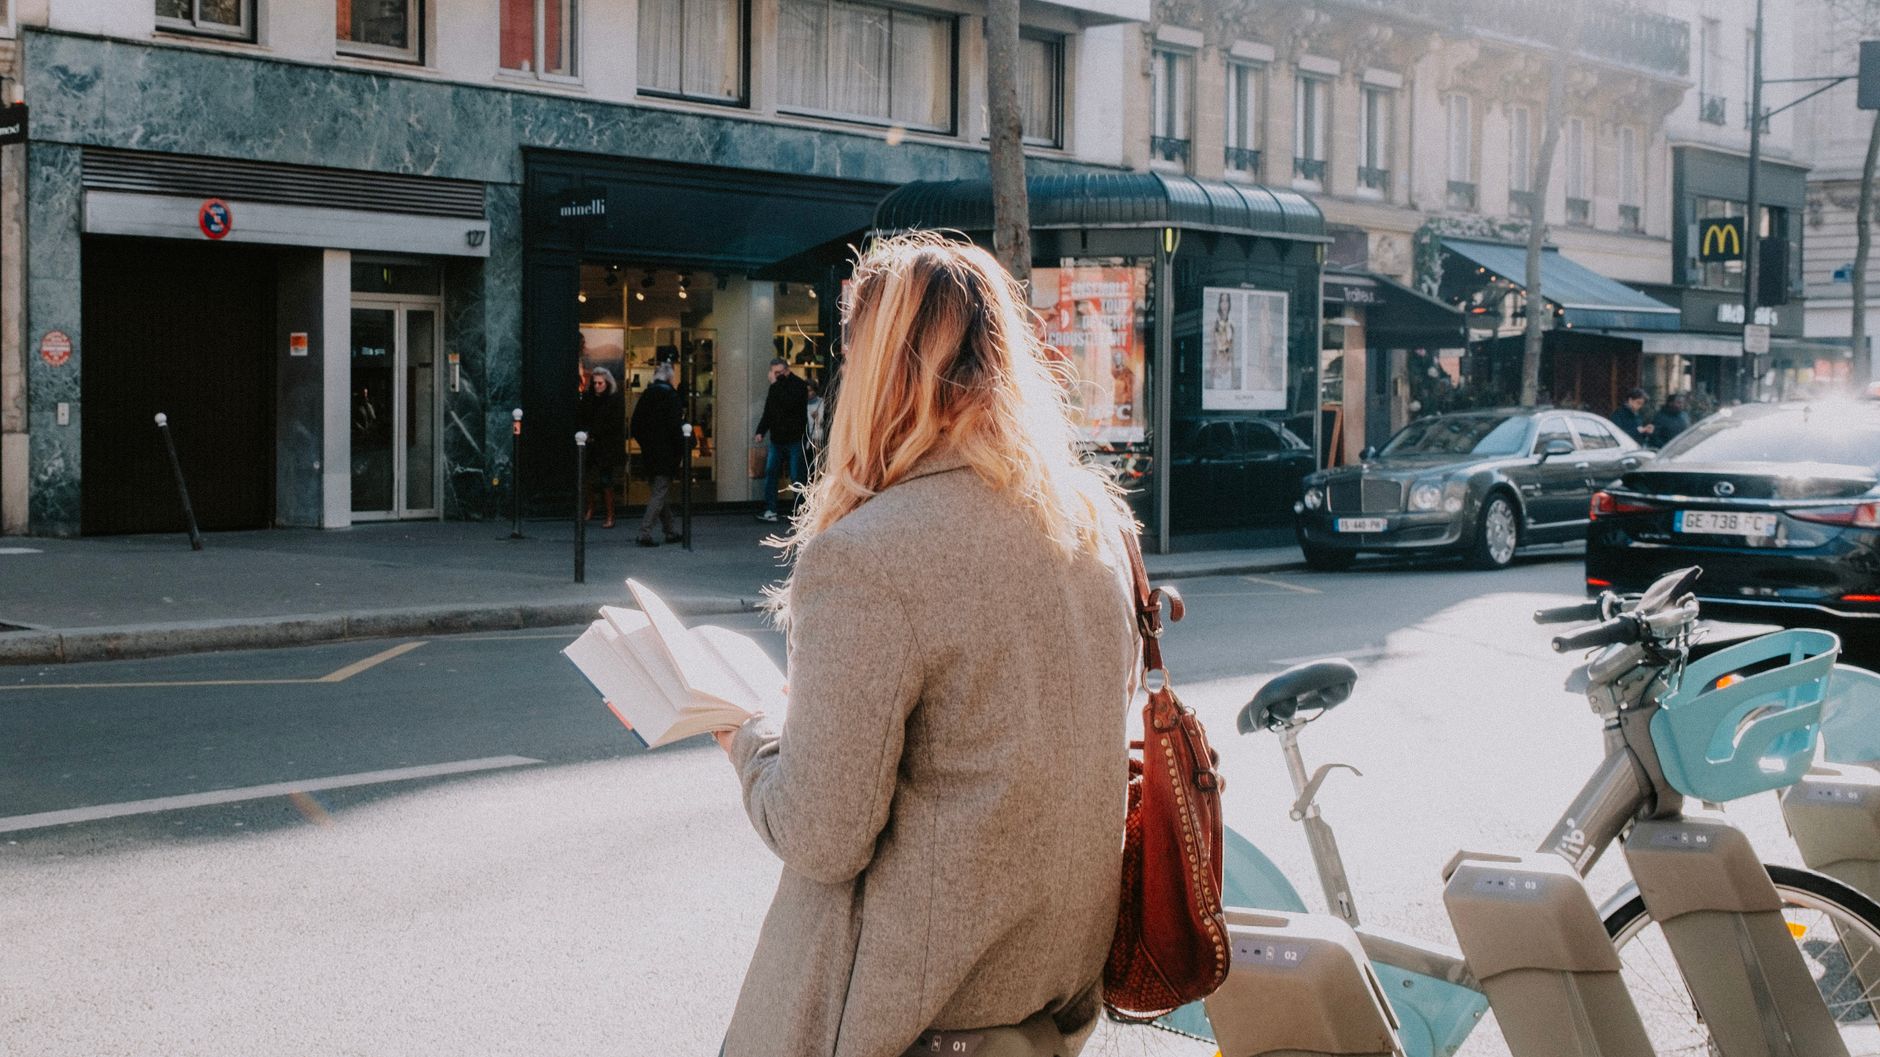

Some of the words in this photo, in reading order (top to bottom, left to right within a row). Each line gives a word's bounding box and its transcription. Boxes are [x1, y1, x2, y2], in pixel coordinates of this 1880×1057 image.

[560, 200, 605, 217] minelli
[465, 229, 486, 247] 127
[1696, 835, 1707, 843] 04
[1524, 880, 1537, 890] 03
[1284, 950, 1298, 961] 02
[952, 1040, 967, 1053] 01
